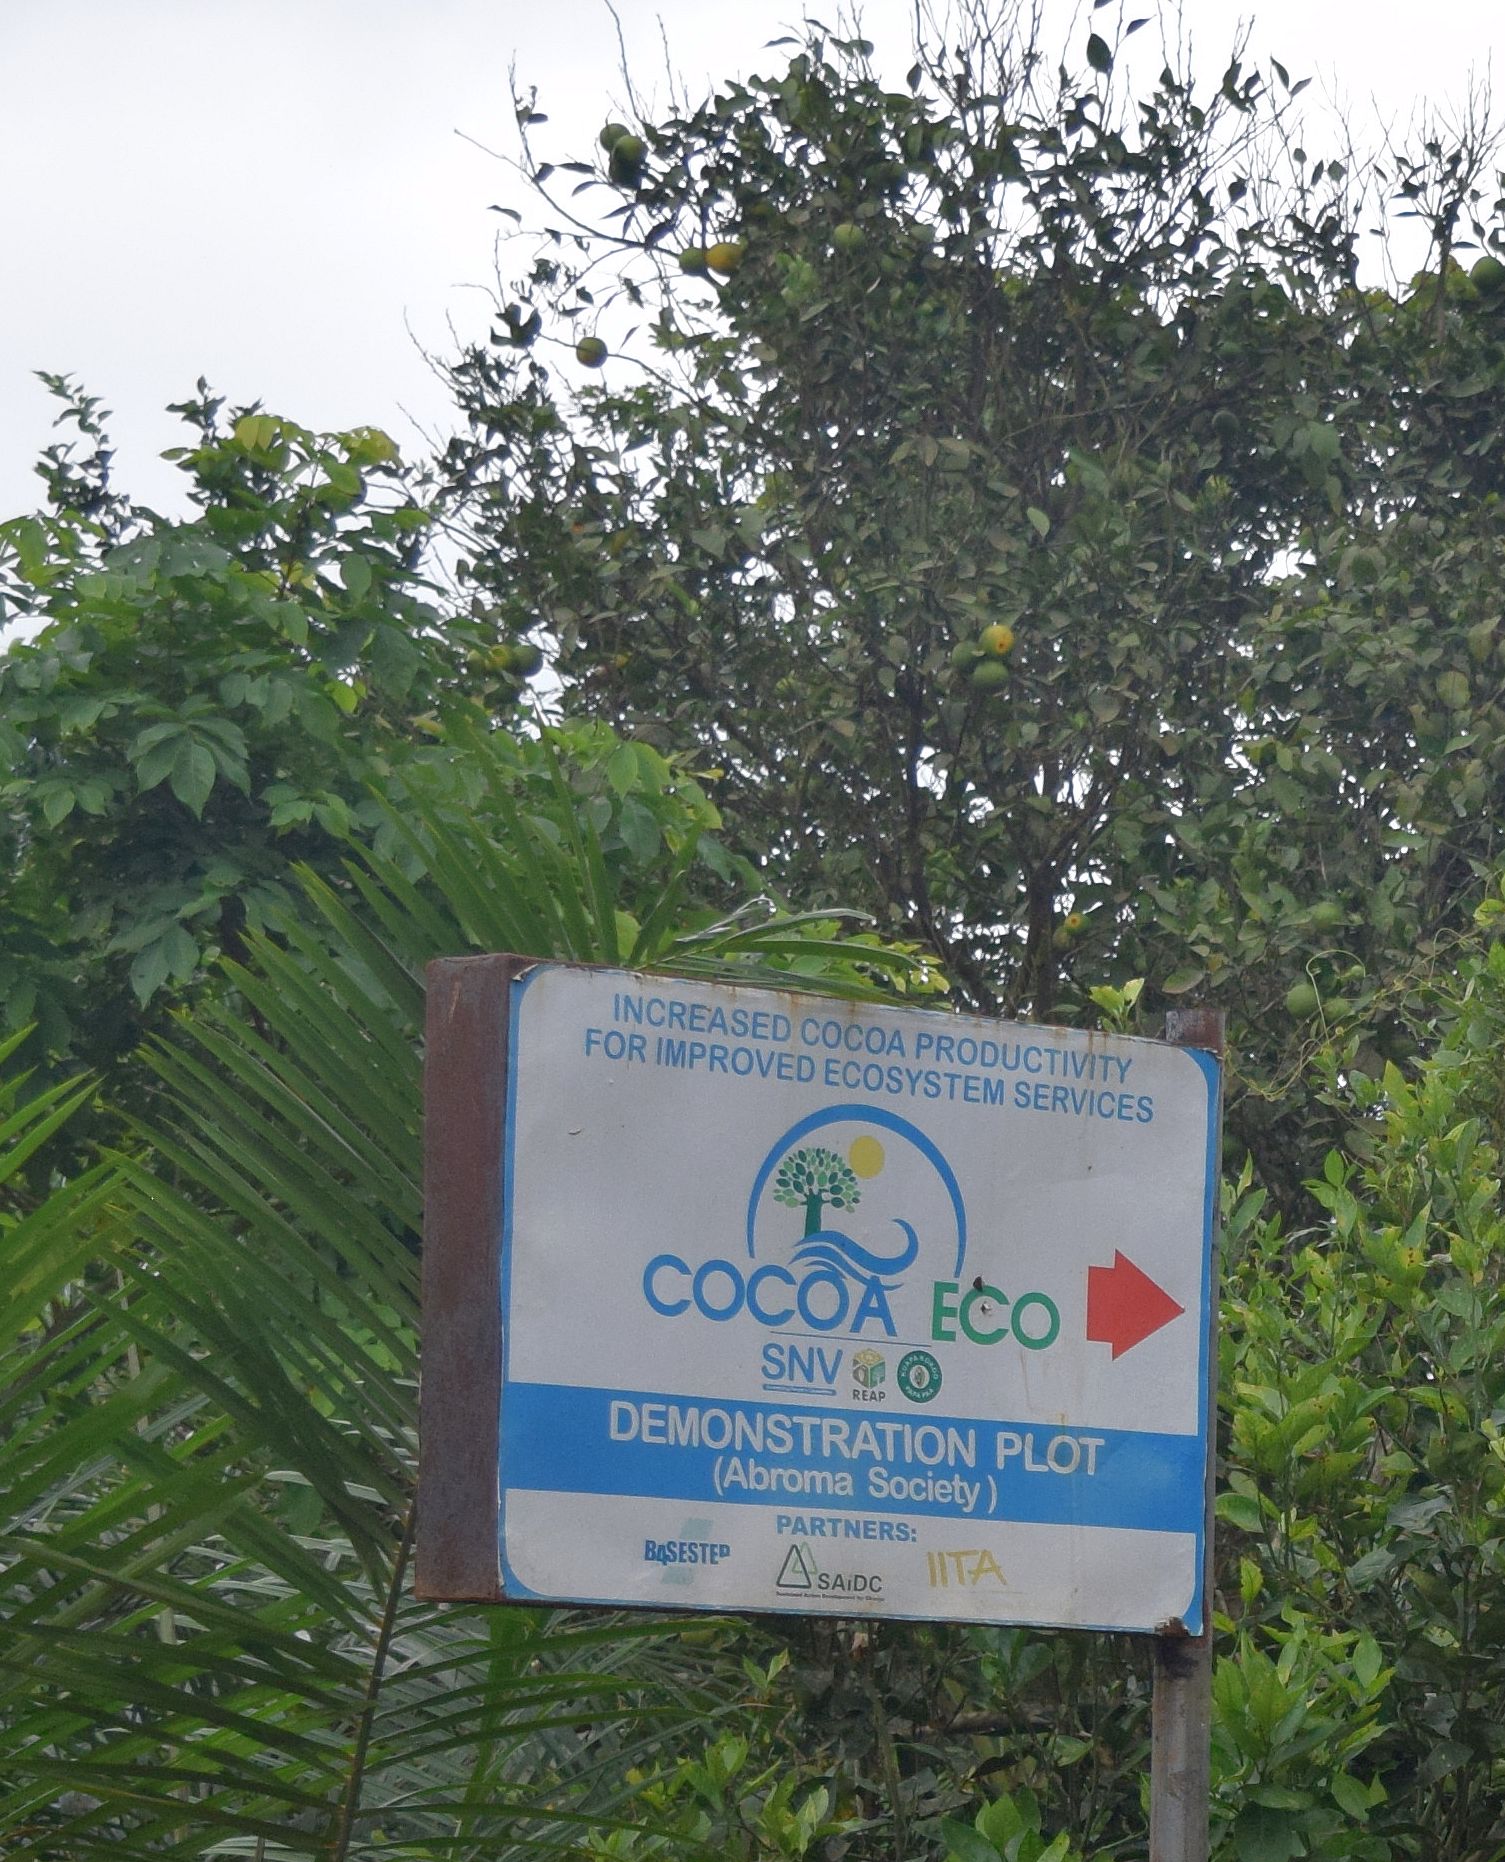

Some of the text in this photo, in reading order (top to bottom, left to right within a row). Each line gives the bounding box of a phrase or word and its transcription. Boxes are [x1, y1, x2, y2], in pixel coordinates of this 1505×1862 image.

[614, 993, 1133, 1084] INCREASED COCOA PRODUCTIVITY
[584, 1027, 1155, 1124] FOR IMPROVED ECOSYSTEM SERVICES
[643, 1254, 1061, 1350] COCOA ECO
[761, 1342, 844, 1385] SNV
[852, 1388, 886, 1403] REAP
[609, 1400, 1106, 1476] DEMONSTRATION PLOT
[713, 1456, 854, 1497] (Abroma
[776, 1514, 918, 1543] PARTNERS:
[927, 1548, 1009, 1588] IITA
